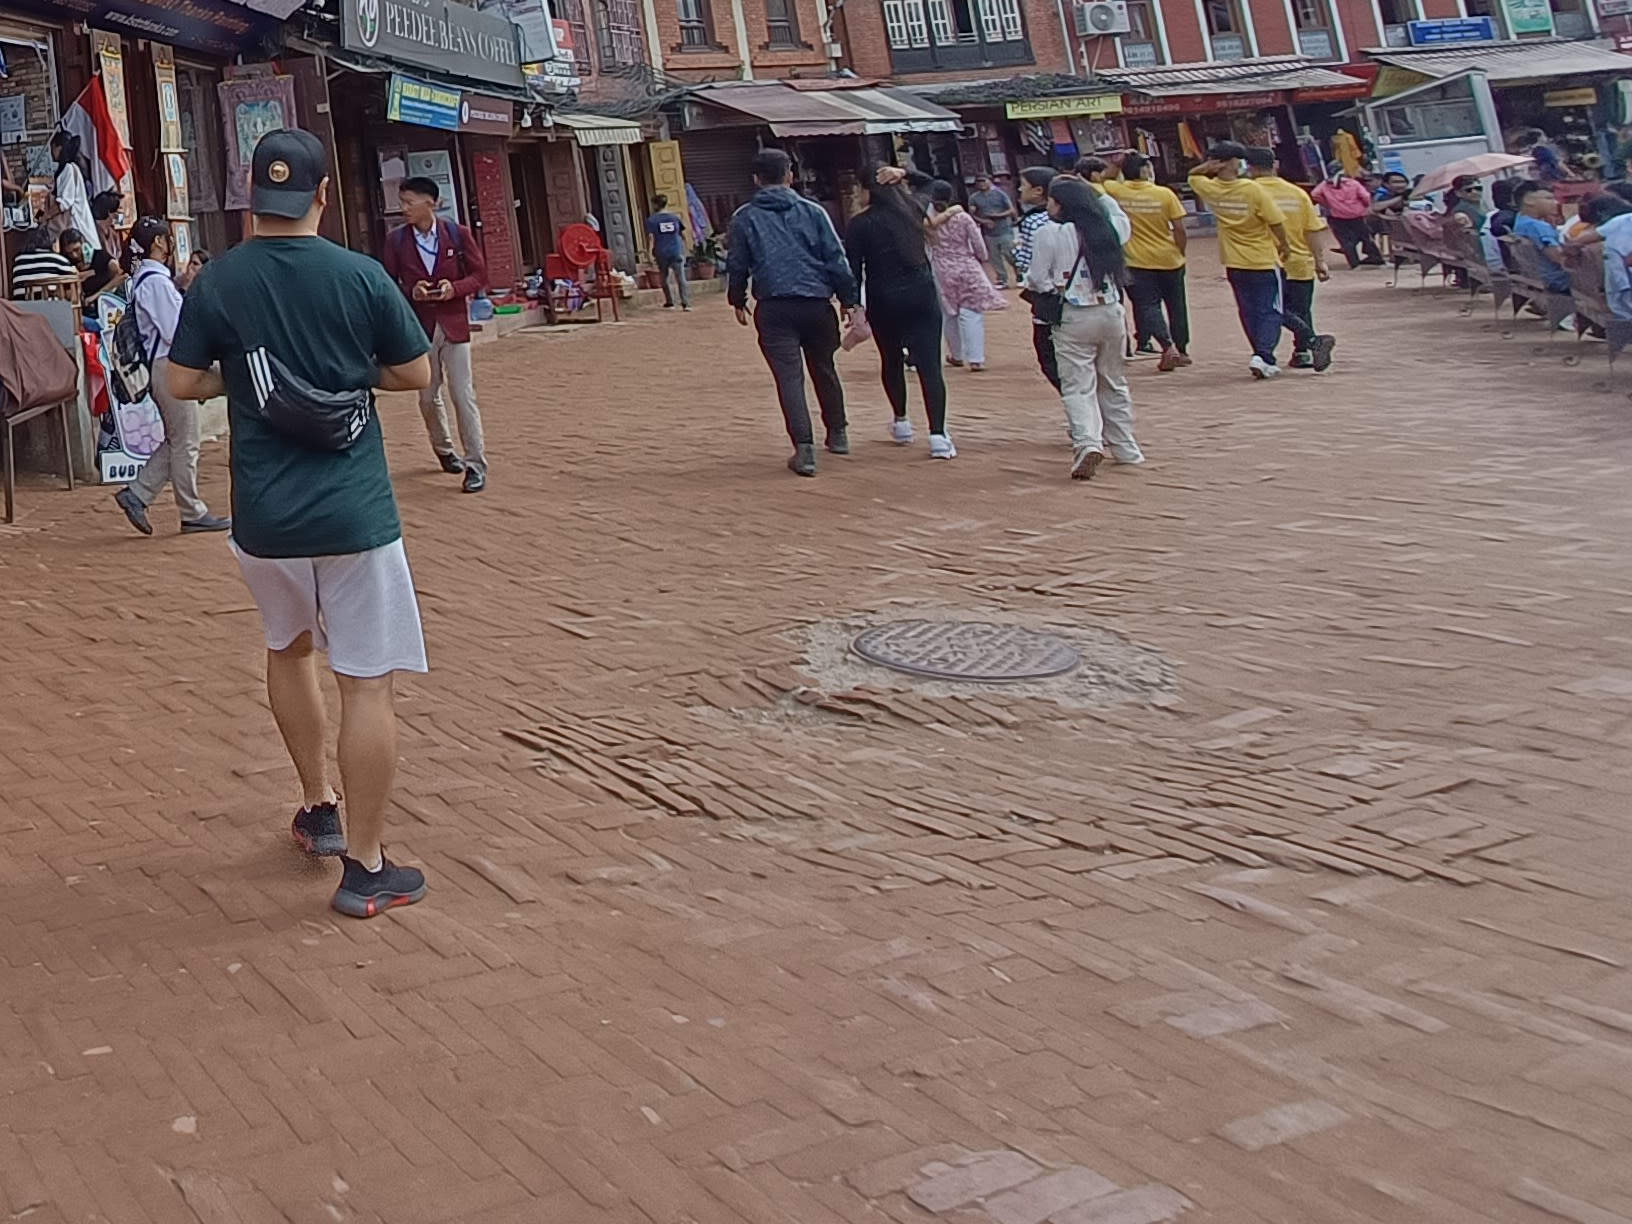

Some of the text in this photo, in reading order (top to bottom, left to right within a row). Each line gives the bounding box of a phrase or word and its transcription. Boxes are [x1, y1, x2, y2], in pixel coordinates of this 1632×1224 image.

[385, 1, 439, 47] PEEDEE
[440, 20, 477, 57] BEANS
[1011, 96, 1102, 113] PERSIAN ART
